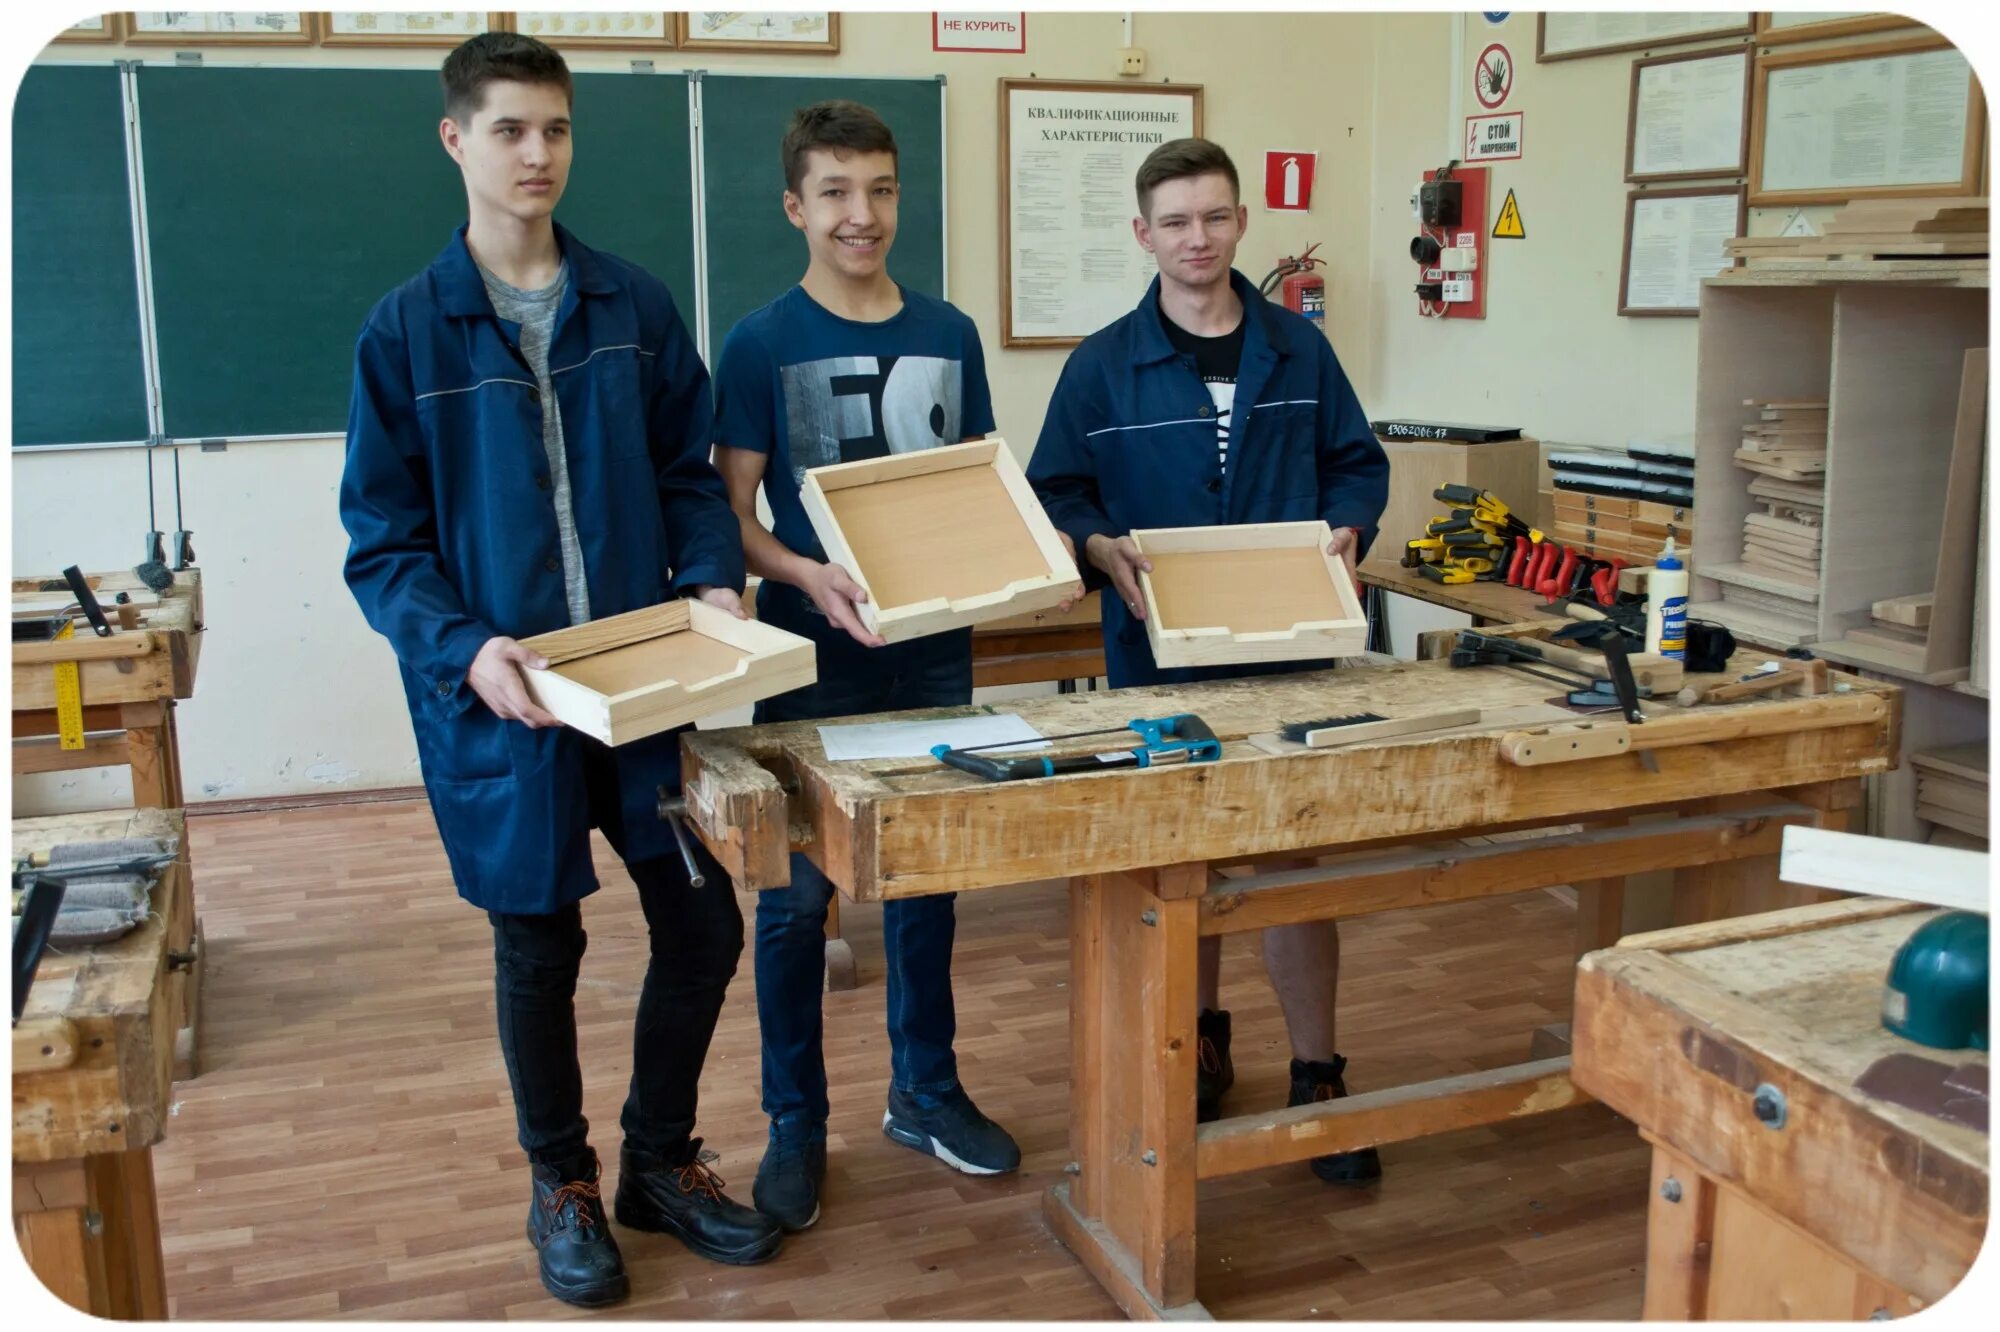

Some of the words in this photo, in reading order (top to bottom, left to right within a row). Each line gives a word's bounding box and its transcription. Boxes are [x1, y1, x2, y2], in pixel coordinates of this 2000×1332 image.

[943, 20, 962, 31] НЕ
[965, 20, 1016, 32] КУРИТЬ
[1027, 107, 1180, 124] КВАЛИФИКАЦИОННЫЕ
[1041, 129, 1164, 145] ХАРАКТЕРИСТИКИ
[1487, 120, 1511, 140] СТОЙ
[1480, 142, 1517, 154] НАПРЯЖЕНИЕ
